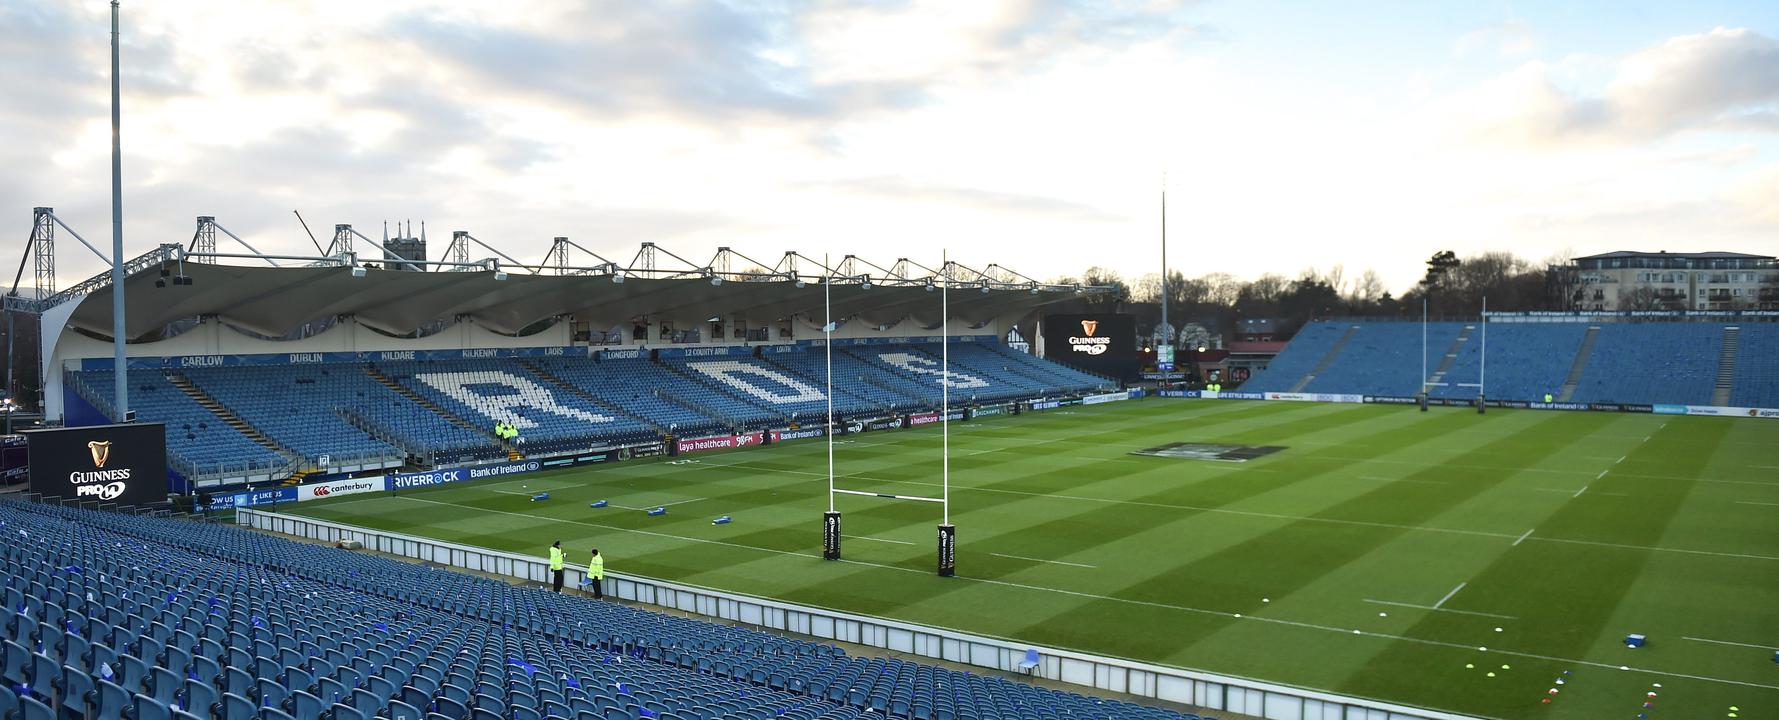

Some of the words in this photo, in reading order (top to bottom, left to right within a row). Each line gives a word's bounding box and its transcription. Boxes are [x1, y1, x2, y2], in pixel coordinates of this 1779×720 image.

[1068, 336, 1110, 344] GUINNESS
[381, 351, 416, 360] KILDARE
[462, 348, 498, 358] KILKENNY
[544, 346, 564, 356] LAOIS
[607, 350, 639, 359] LONGFORD
[181, 356, 224, 366] CARLOW
[290, 353, 323, 363] DUBLIN
[914, 416, 938, 424] healthcare
[679, 442, 694, 452] laya
[695, 439, 731, 450] healthcare
[470, 468, 491, 478] Bank
[492, 466, 500, 476] of
[500, 463, 526, 474] Ireland
[70, 468, 131, 484] GUINNESS
[331, 482, 372, 493] canterbury
